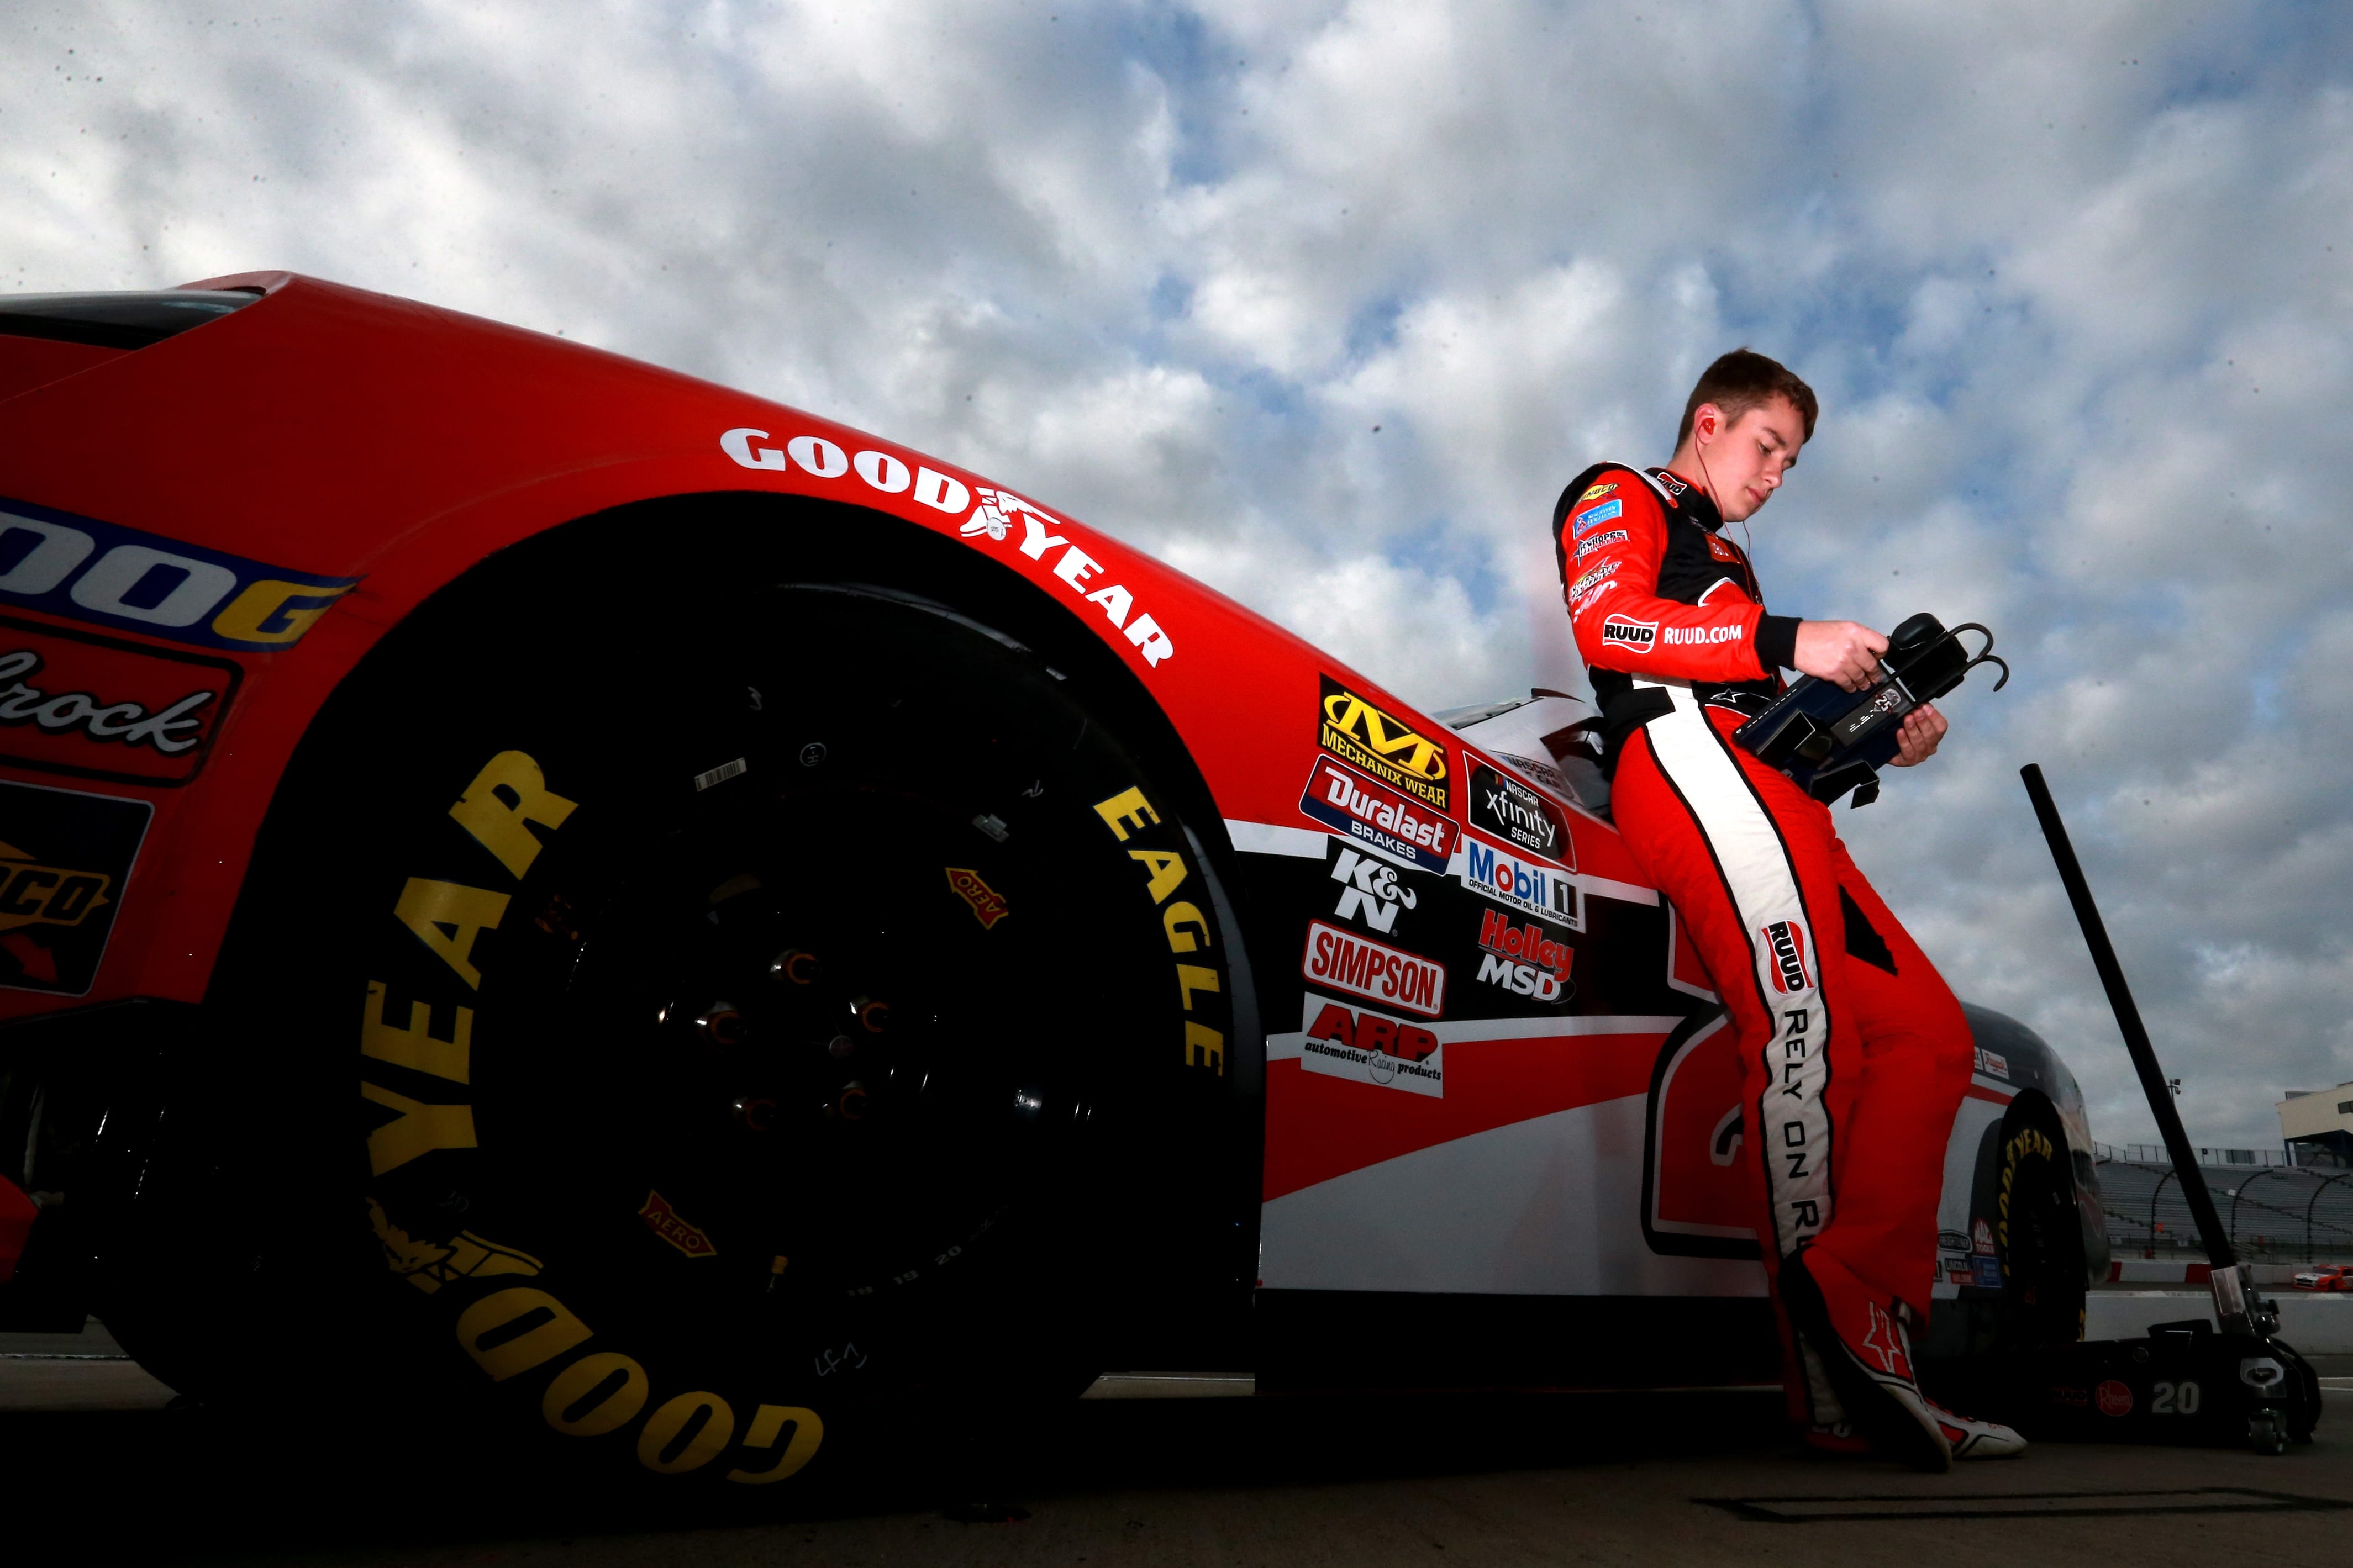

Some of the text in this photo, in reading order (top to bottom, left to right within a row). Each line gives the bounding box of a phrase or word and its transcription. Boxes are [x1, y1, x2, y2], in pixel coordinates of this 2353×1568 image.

[1604, 624, 1654, 642] RUUD
[1664, 625, 1742, 645] RUUD.COM
[1322, 723, 1446, 809] MECHANIX WEAR
[1325, 766, 1445, 853] Duralast
[1486, 789, 1556, 847] xfinity
[1506, 780, 1539, 807] NASCAR
[1351, 820, 1416, 859] BRAKES
[1511, 827, 1541, 849] SERIES
[956, 876, 1002, 913] AERO
[1468, 879, 1497, 897] OFFICIAL
[1498, 891, 1522, 907] MOTOR
[1523, 899, 1533, 911] OIL
[1540, 907, 1578, 927] LUBRICANTS
[1469, 841, 1569, 914] Mobil 1
[1092, 785, 1224, 1078] EAGLE
[1478, 907, 1575, 982] Holley
[1768, 921, 1805, 992] RUUD
[1312, 931, 1437, 1009] SIMPSON
[1476, 953, 1561, 1001] MSD
[1307, 1003, 1438, 1063] ARP
[1783, 1009, 1808, 1101] RELY
[1304, 1042, 1368, 1064] automotive
[1397, 1062, 1441, 1080] products
[1783, 1120, 1809, 1179] ON
[646, 1211, 701, 1249] AERO
[2152, 1380, 2201, 1415] 20
